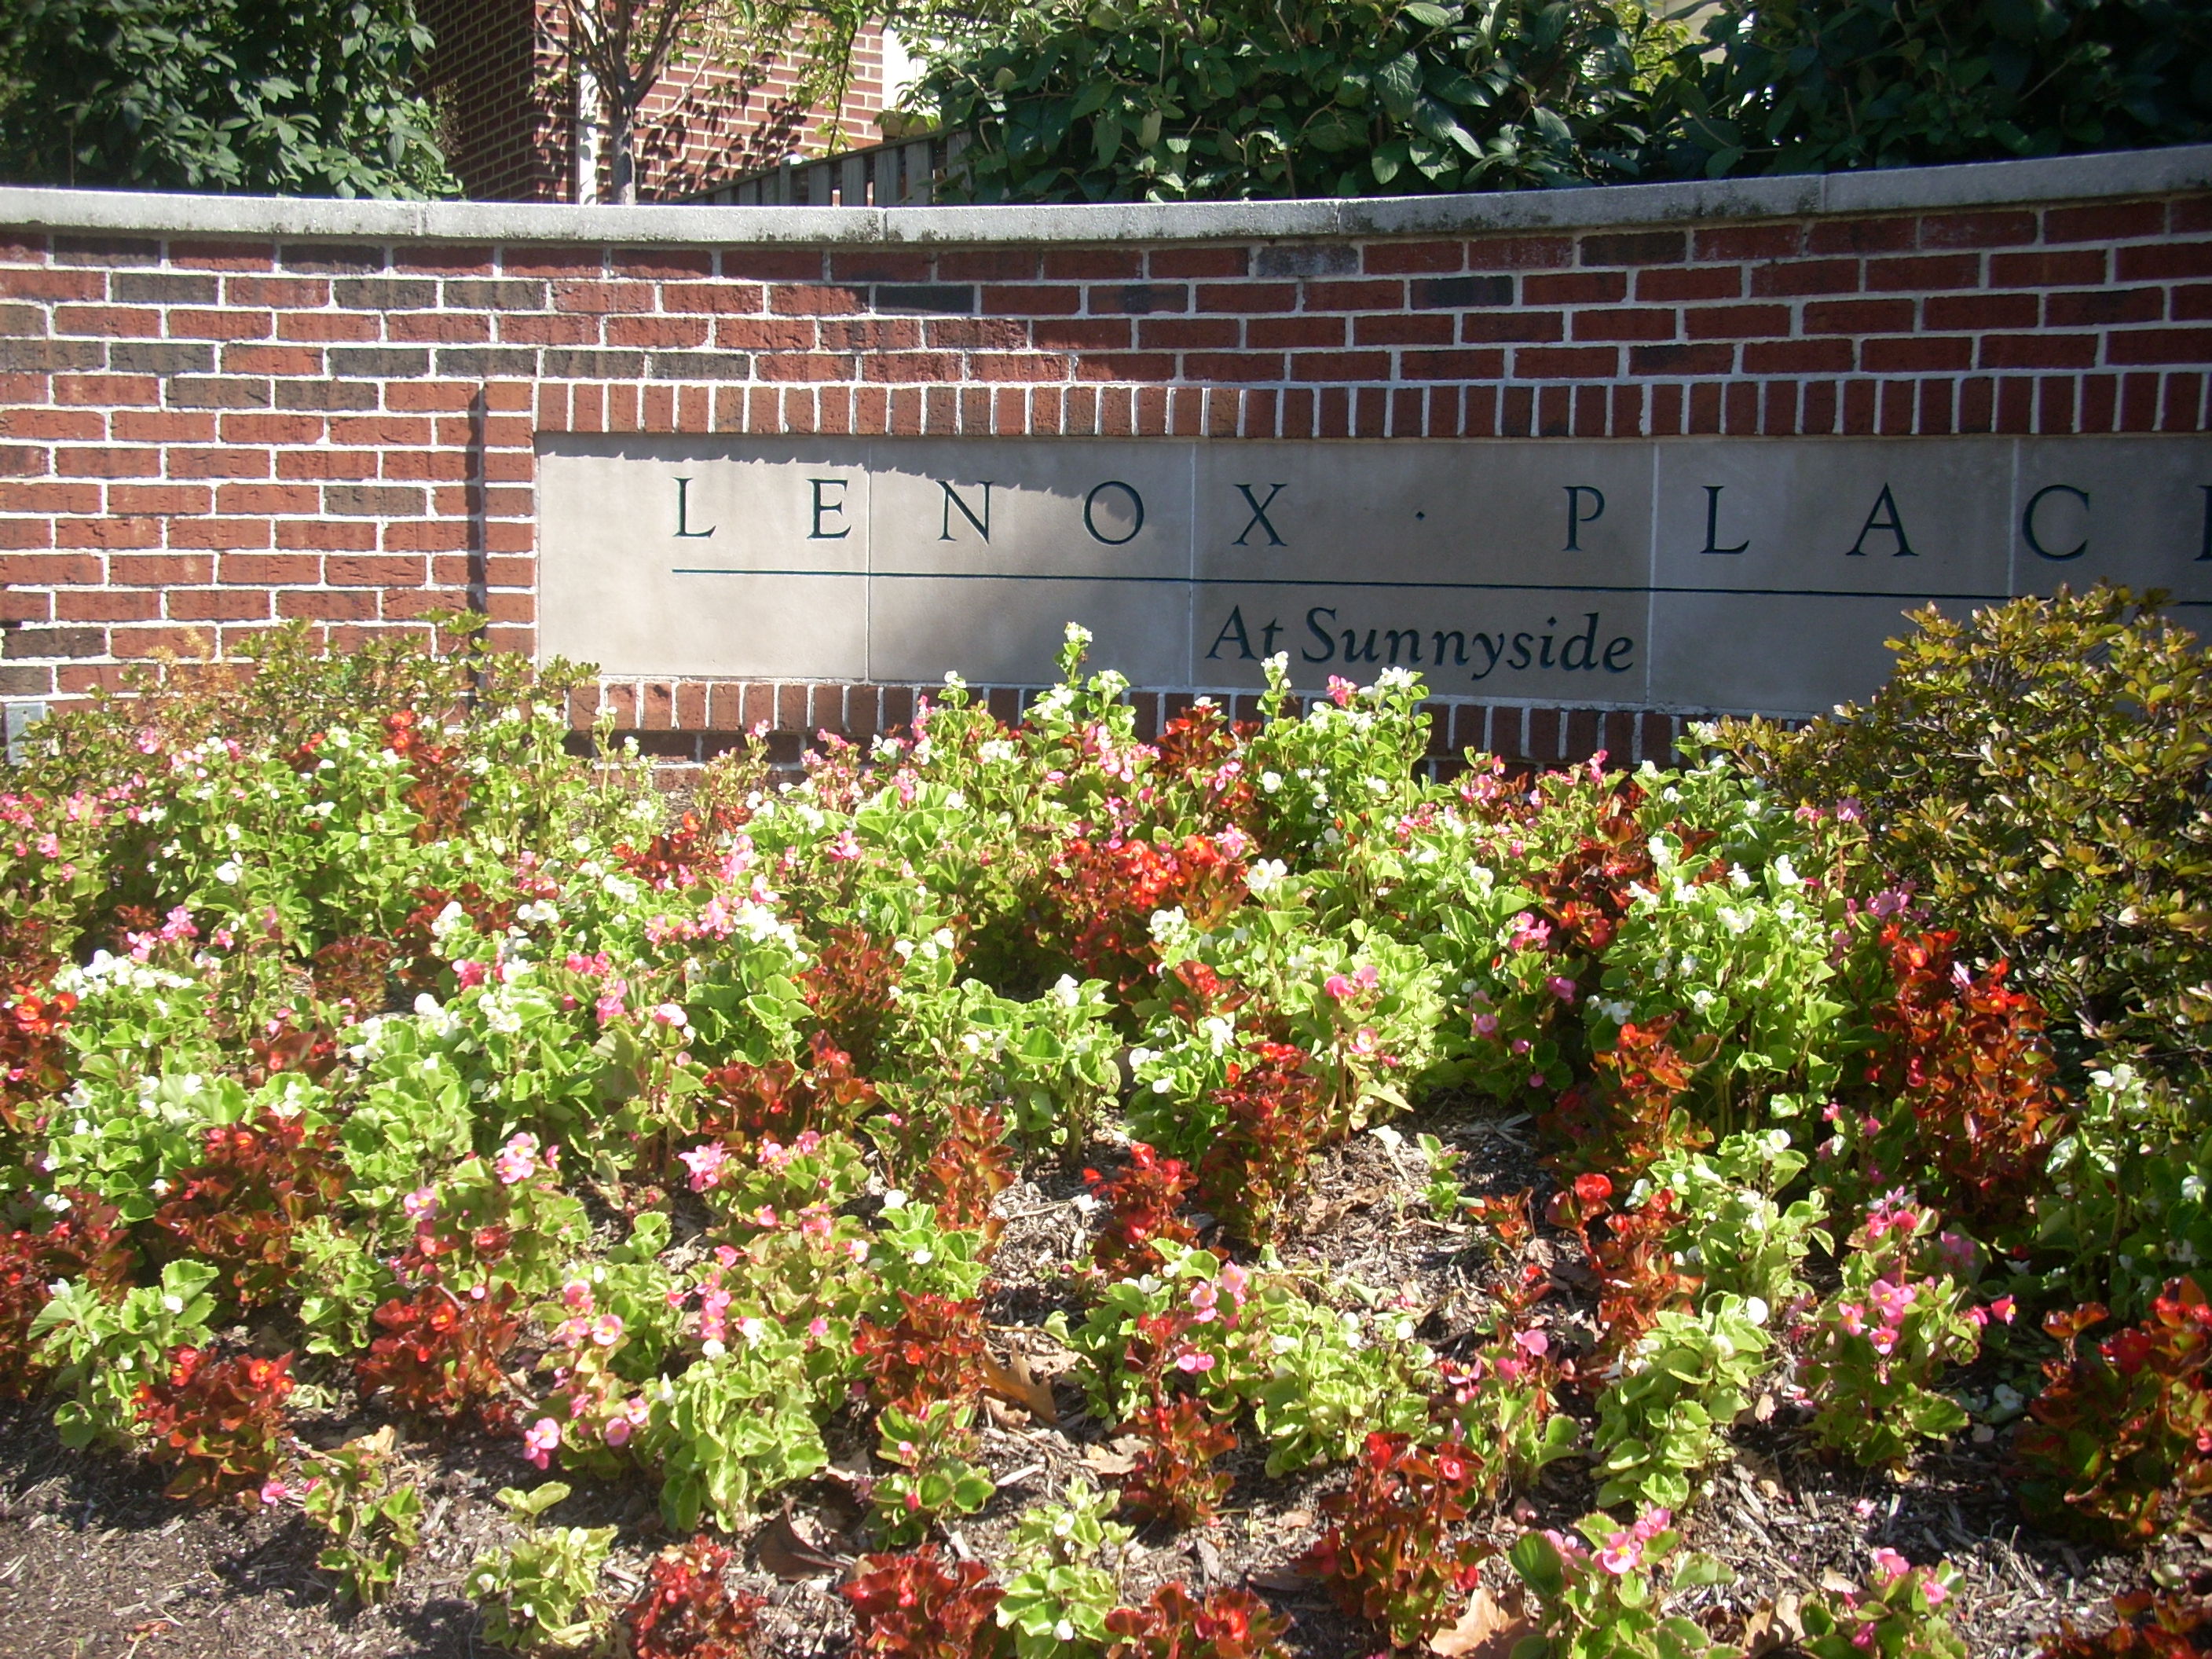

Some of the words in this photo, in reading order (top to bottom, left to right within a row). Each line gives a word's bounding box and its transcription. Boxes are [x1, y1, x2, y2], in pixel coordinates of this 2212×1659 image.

[672, 476, 1288, 547] LENOX
[1205, 603, 1284, 661] At
[1301, 606, 1635, 681] Sunnyside
